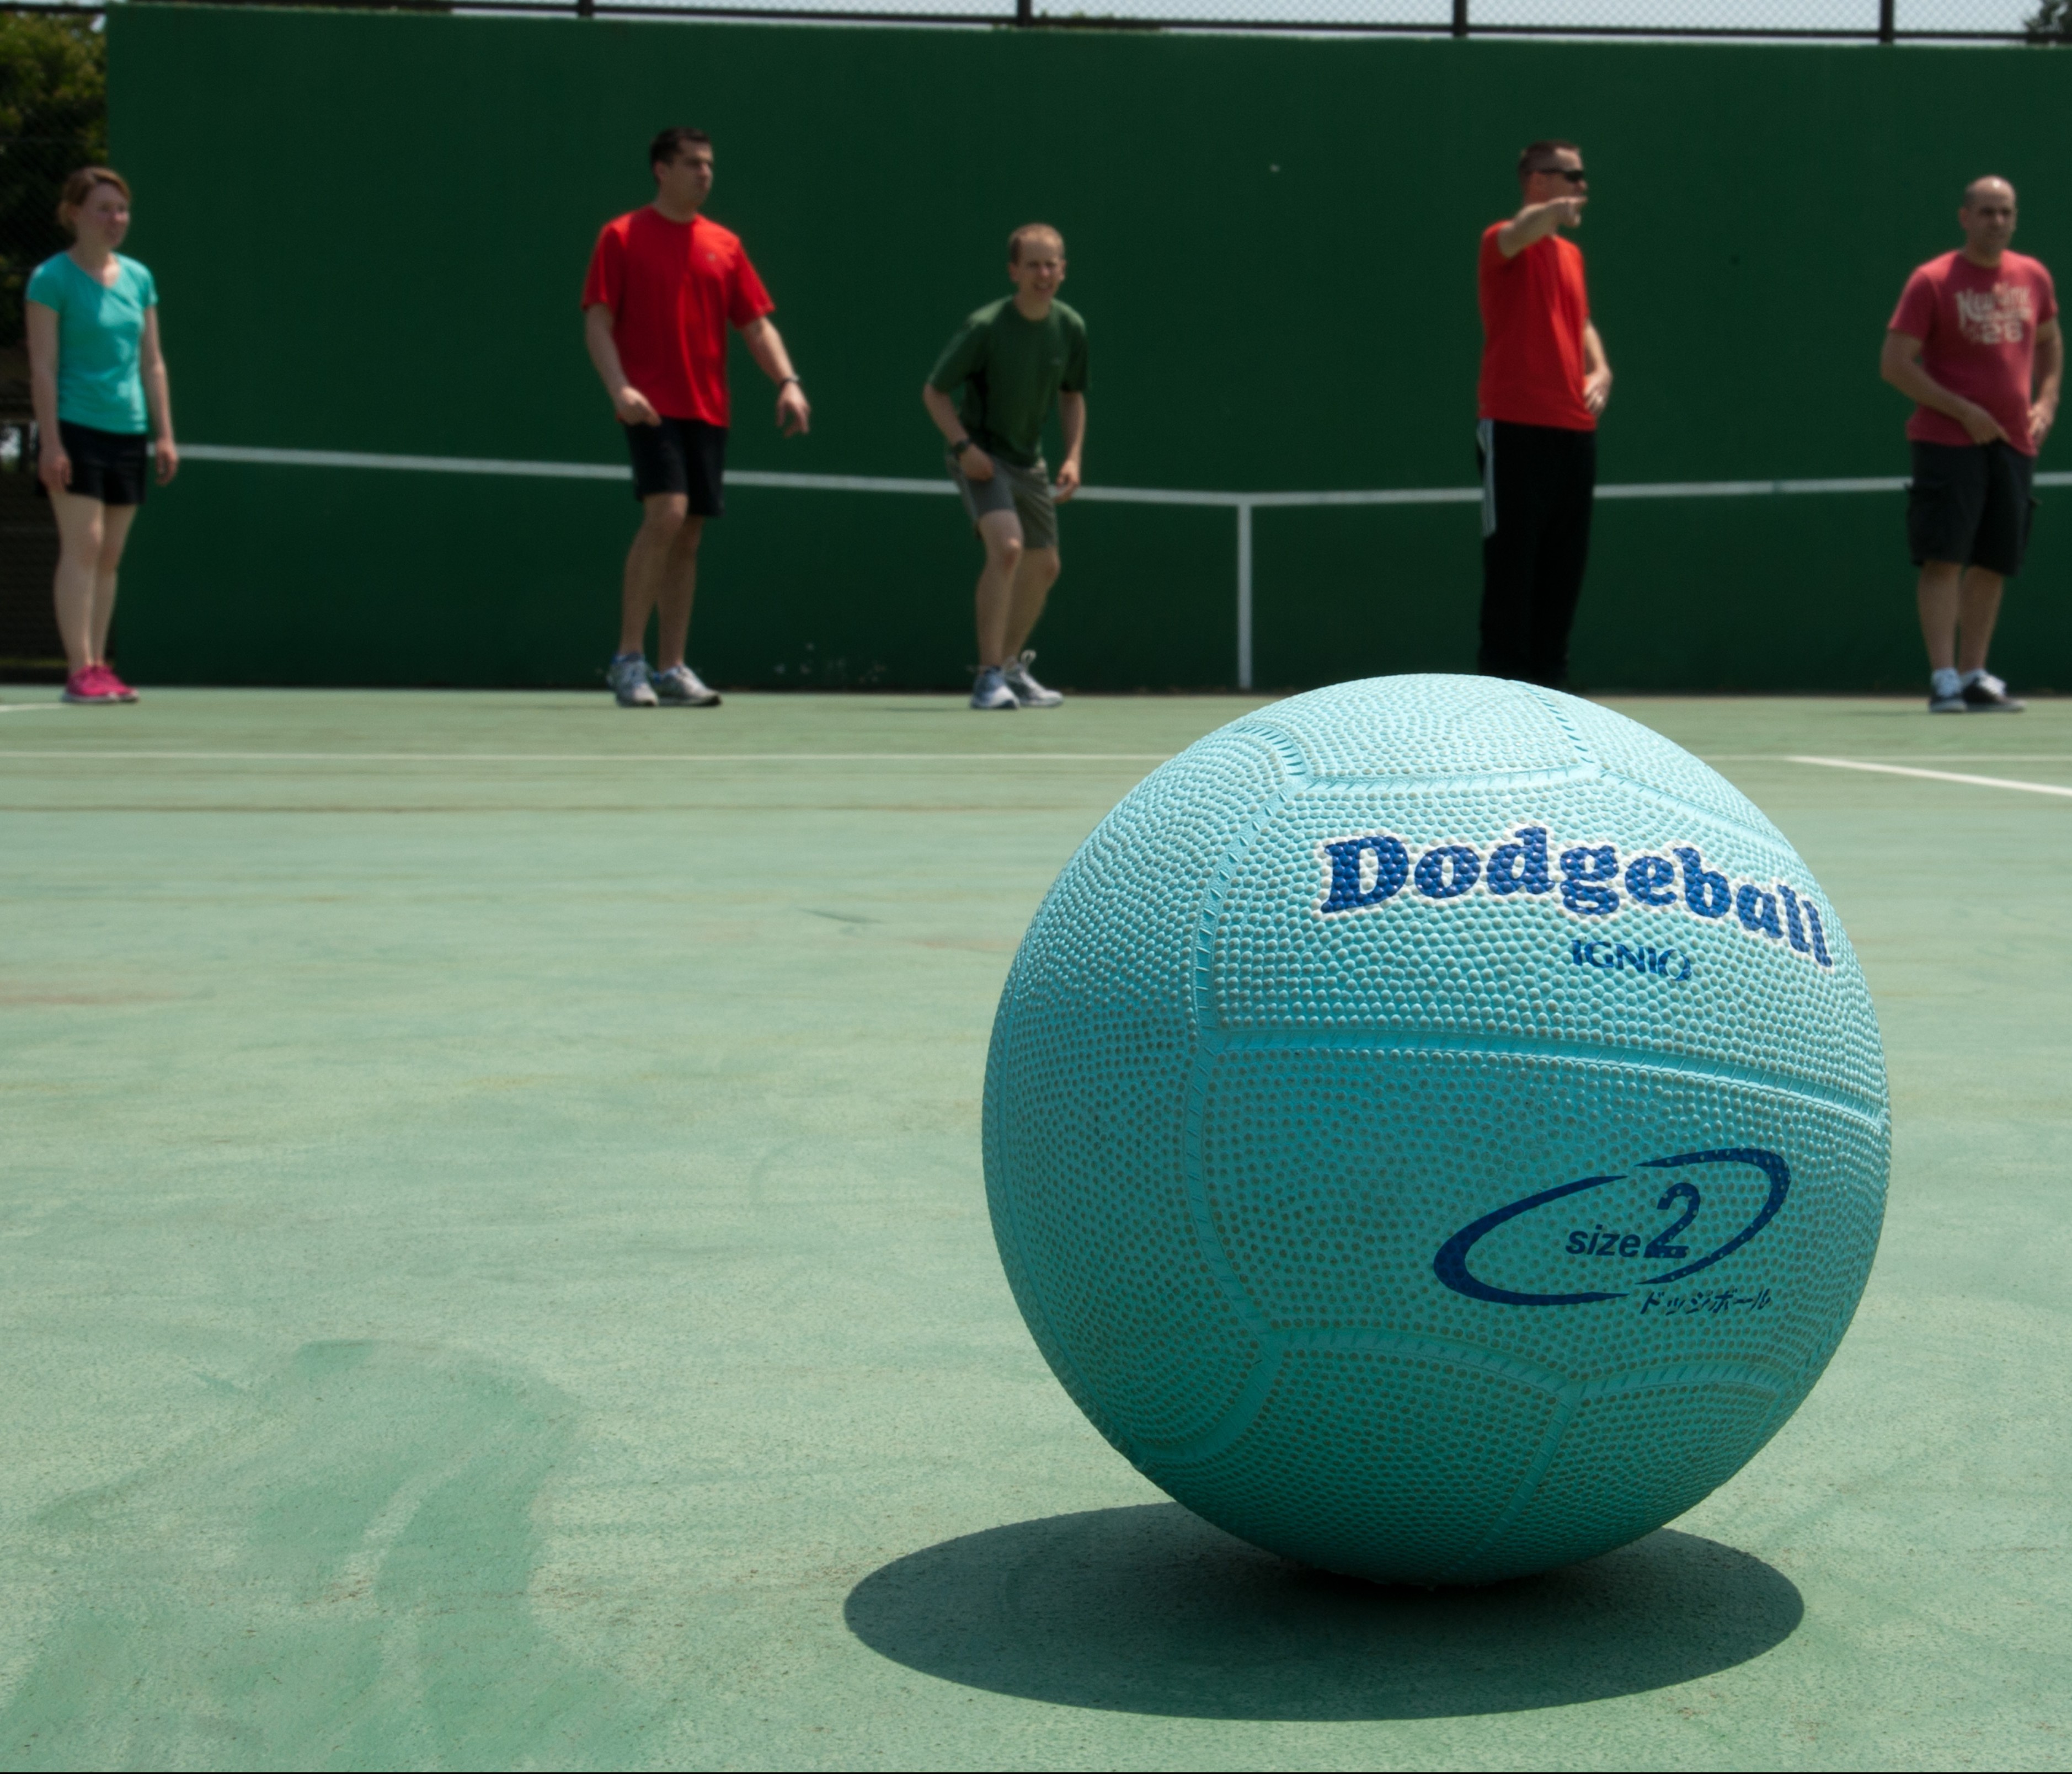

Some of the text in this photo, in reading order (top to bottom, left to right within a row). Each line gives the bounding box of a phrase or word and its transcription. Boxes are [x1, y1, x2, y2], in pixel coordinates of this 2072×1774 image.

[1320, 825, 1834, 968] Dodgeball
[1571, 939, 1692, 981] IGNIO
[1565, 1182, 1701, 1259] size 2
[1640, 1288, 1771, 1316] ドッジボール
